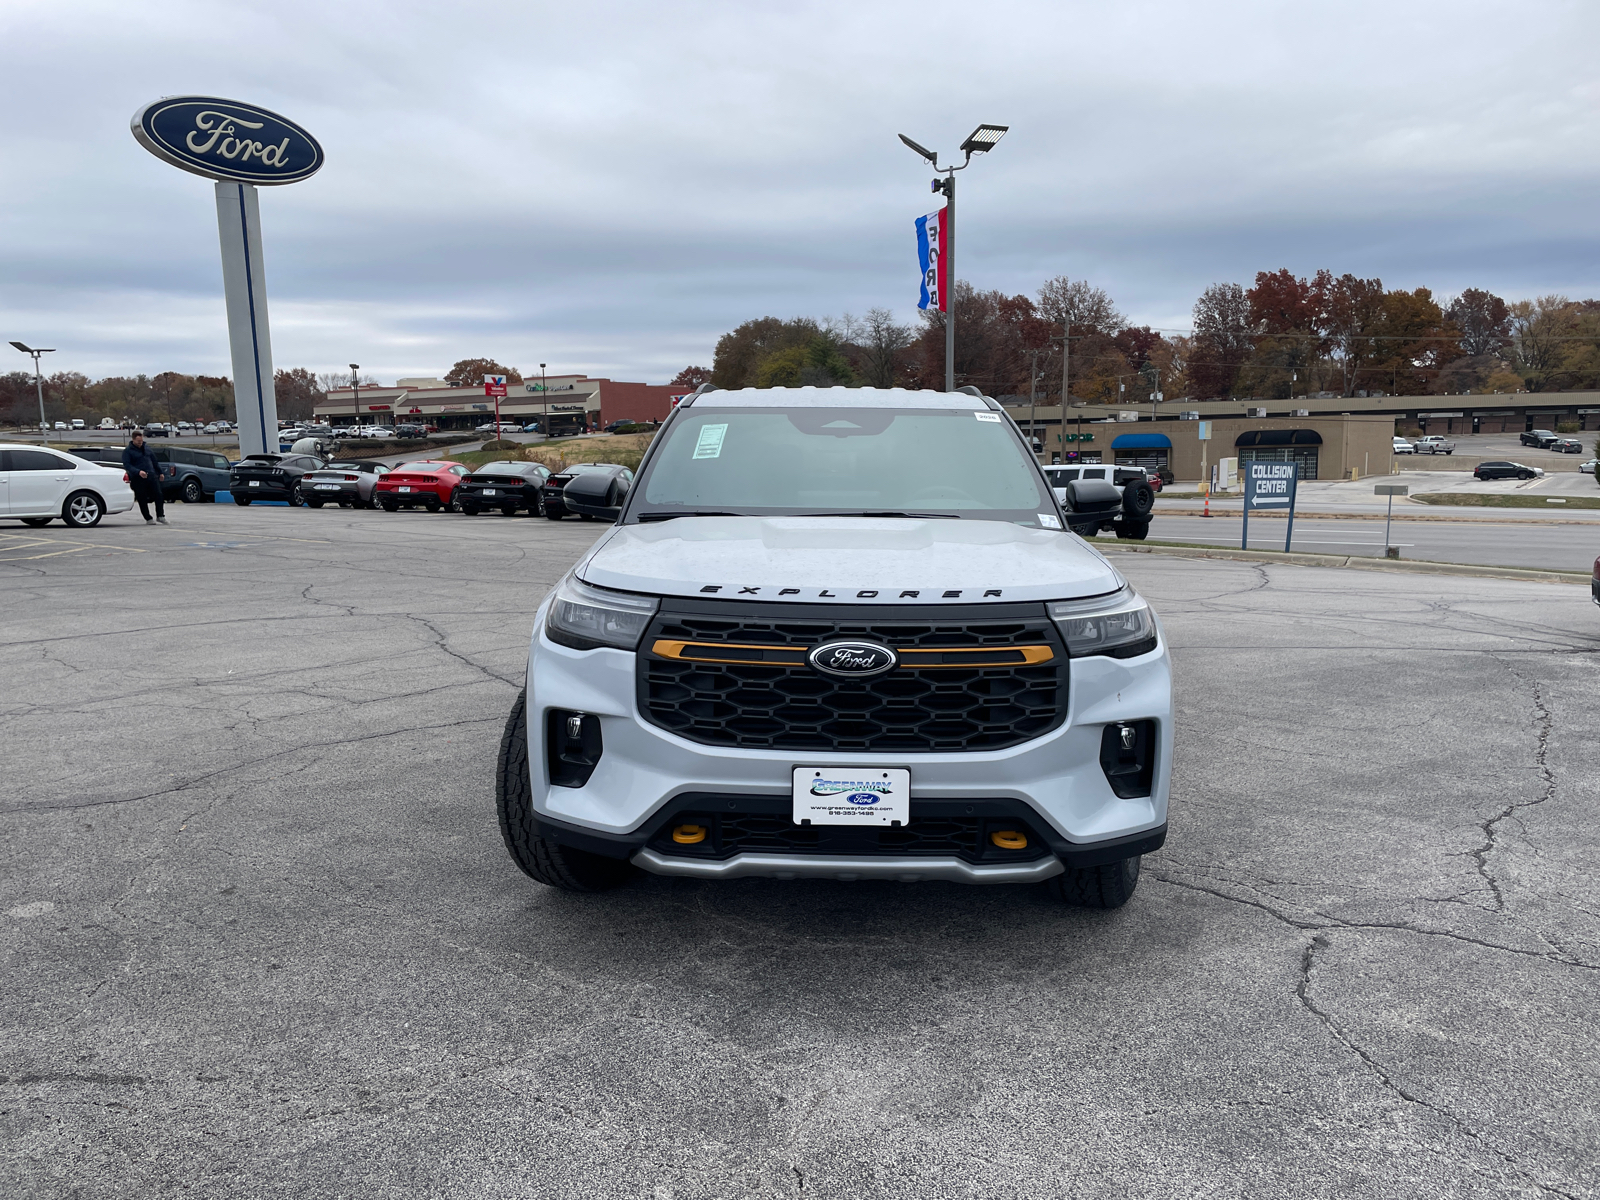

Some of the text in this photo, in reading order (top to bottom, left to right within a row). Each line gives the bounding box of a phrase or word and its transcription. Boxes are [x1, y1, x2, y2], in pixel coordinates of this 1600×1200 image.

[186, 110, 290, 168] Ford
[1251, 464, 1294, 479] COLLISION
[1256, 480, 1287, 494] CENTER
[700, 585, 1003, 599] EXPLORER
[830, 648, 876, 668] Ford
[853, 794, 874, 804] Ford
